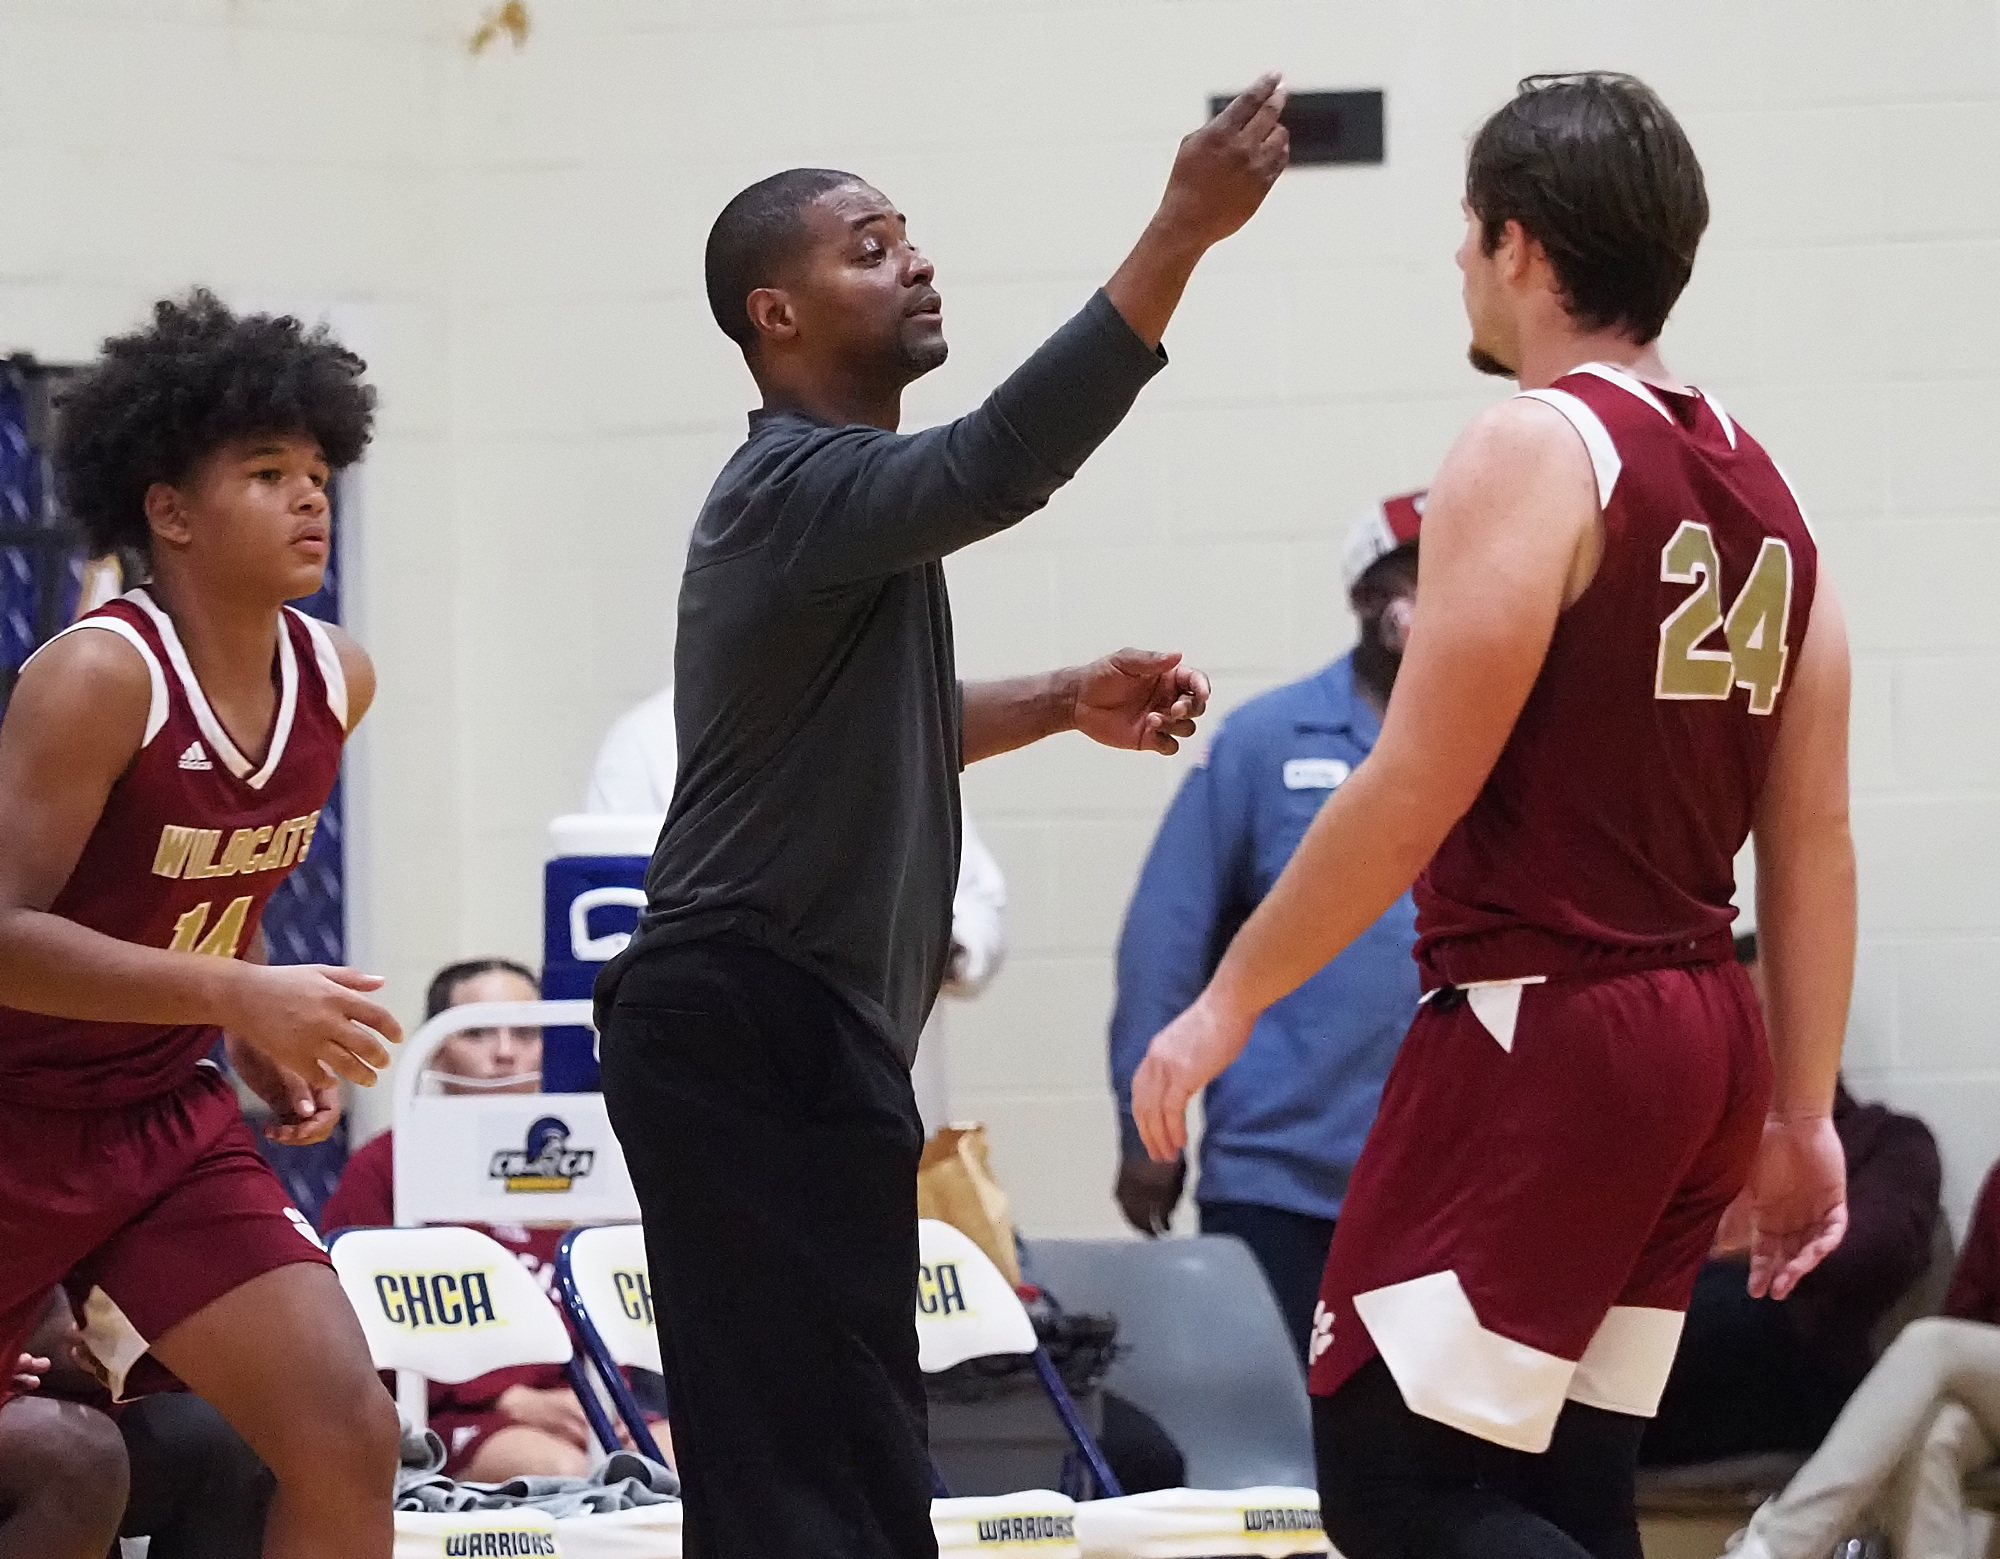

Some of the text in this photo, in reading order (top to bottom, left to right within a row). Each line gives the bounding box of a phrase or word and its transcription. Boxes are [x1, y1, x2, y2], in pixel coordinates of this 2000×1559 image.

[1655, 520, 1793, 715] 24
[152, 809, 322, 880] WILDCATS
[168, 895, 254, 958] 14
[374, 1271, 496, 1328] CHCA
[918, 1264, 967, 1316] CA
[446, 1530, 555, 1558] WARRIORS
[979, 1515, 1075, 1542] WARRIORS
[1244, 1508, 1323, 1533] WARRIOR
